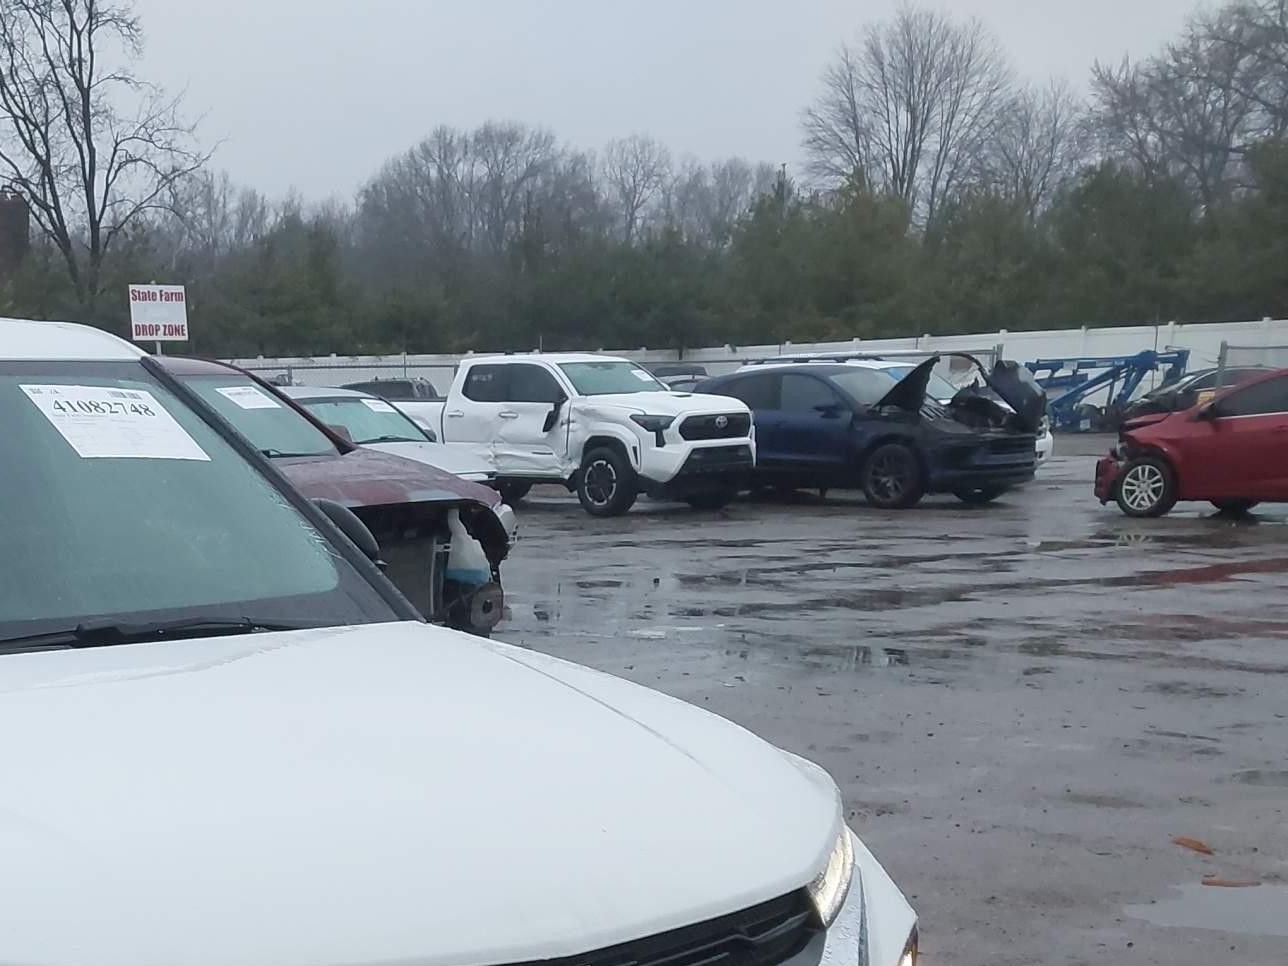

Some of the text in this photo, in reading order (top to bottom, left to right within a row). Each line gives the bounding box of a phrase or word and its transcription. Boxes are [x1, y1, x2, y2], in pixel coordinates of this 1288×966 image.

[131, 289, 184, 302] State Farm
[134, 324, 186, 337] DROP ZONE
[53, 399, 156, 417] 41082748
